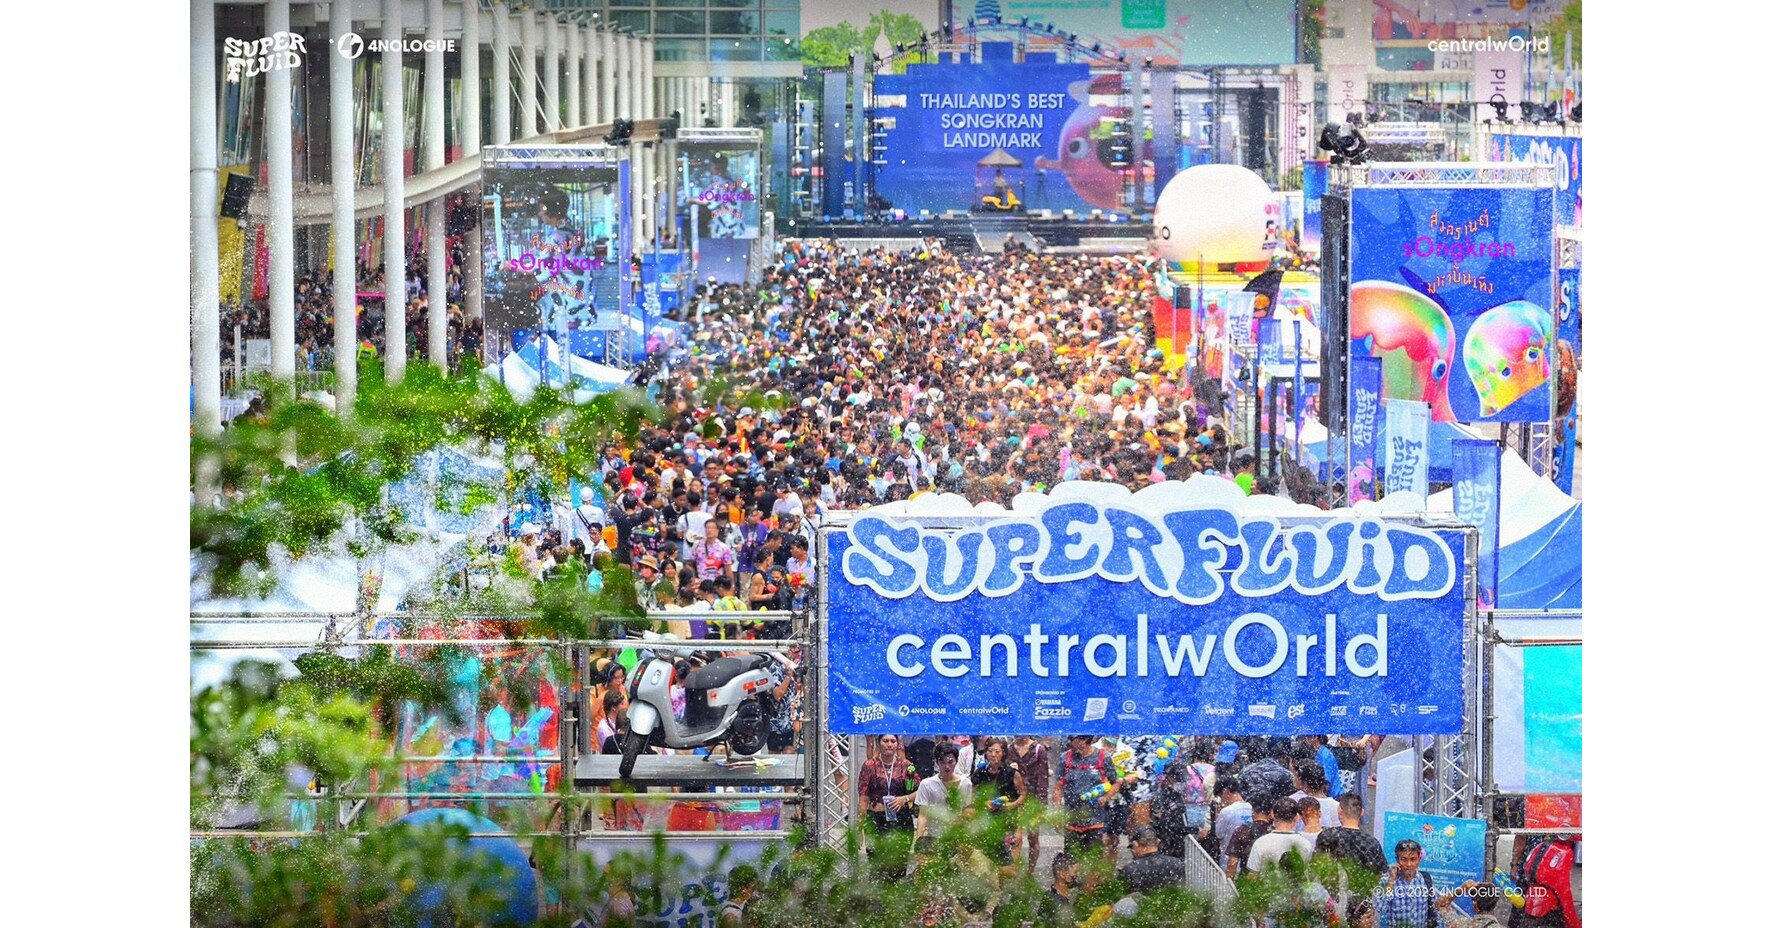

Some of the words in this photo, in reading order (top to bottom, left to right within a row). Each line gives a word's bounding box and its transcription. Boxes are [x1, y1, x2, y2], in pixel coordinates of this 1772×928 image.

[920, 93, 1021, 109] THAILAND'S
[1028, 93, 1065, 109] BEST
[941, 113, 1043, 129] SONGKRAN
[943, 132, 1042, 148] LANDMARK
[1402, 235, 1516, 263] sOngkran
[510, 252, 604, 276] sOngkran
[886, 612, 1388, 678] centralwOrld
[852, 704, 886, 715] SUPER
[959, 706, 1009, 714] centralwOrld
[1035, 706, 1071, 716] Fazzio
[1287, 703, 1305, 719] est
